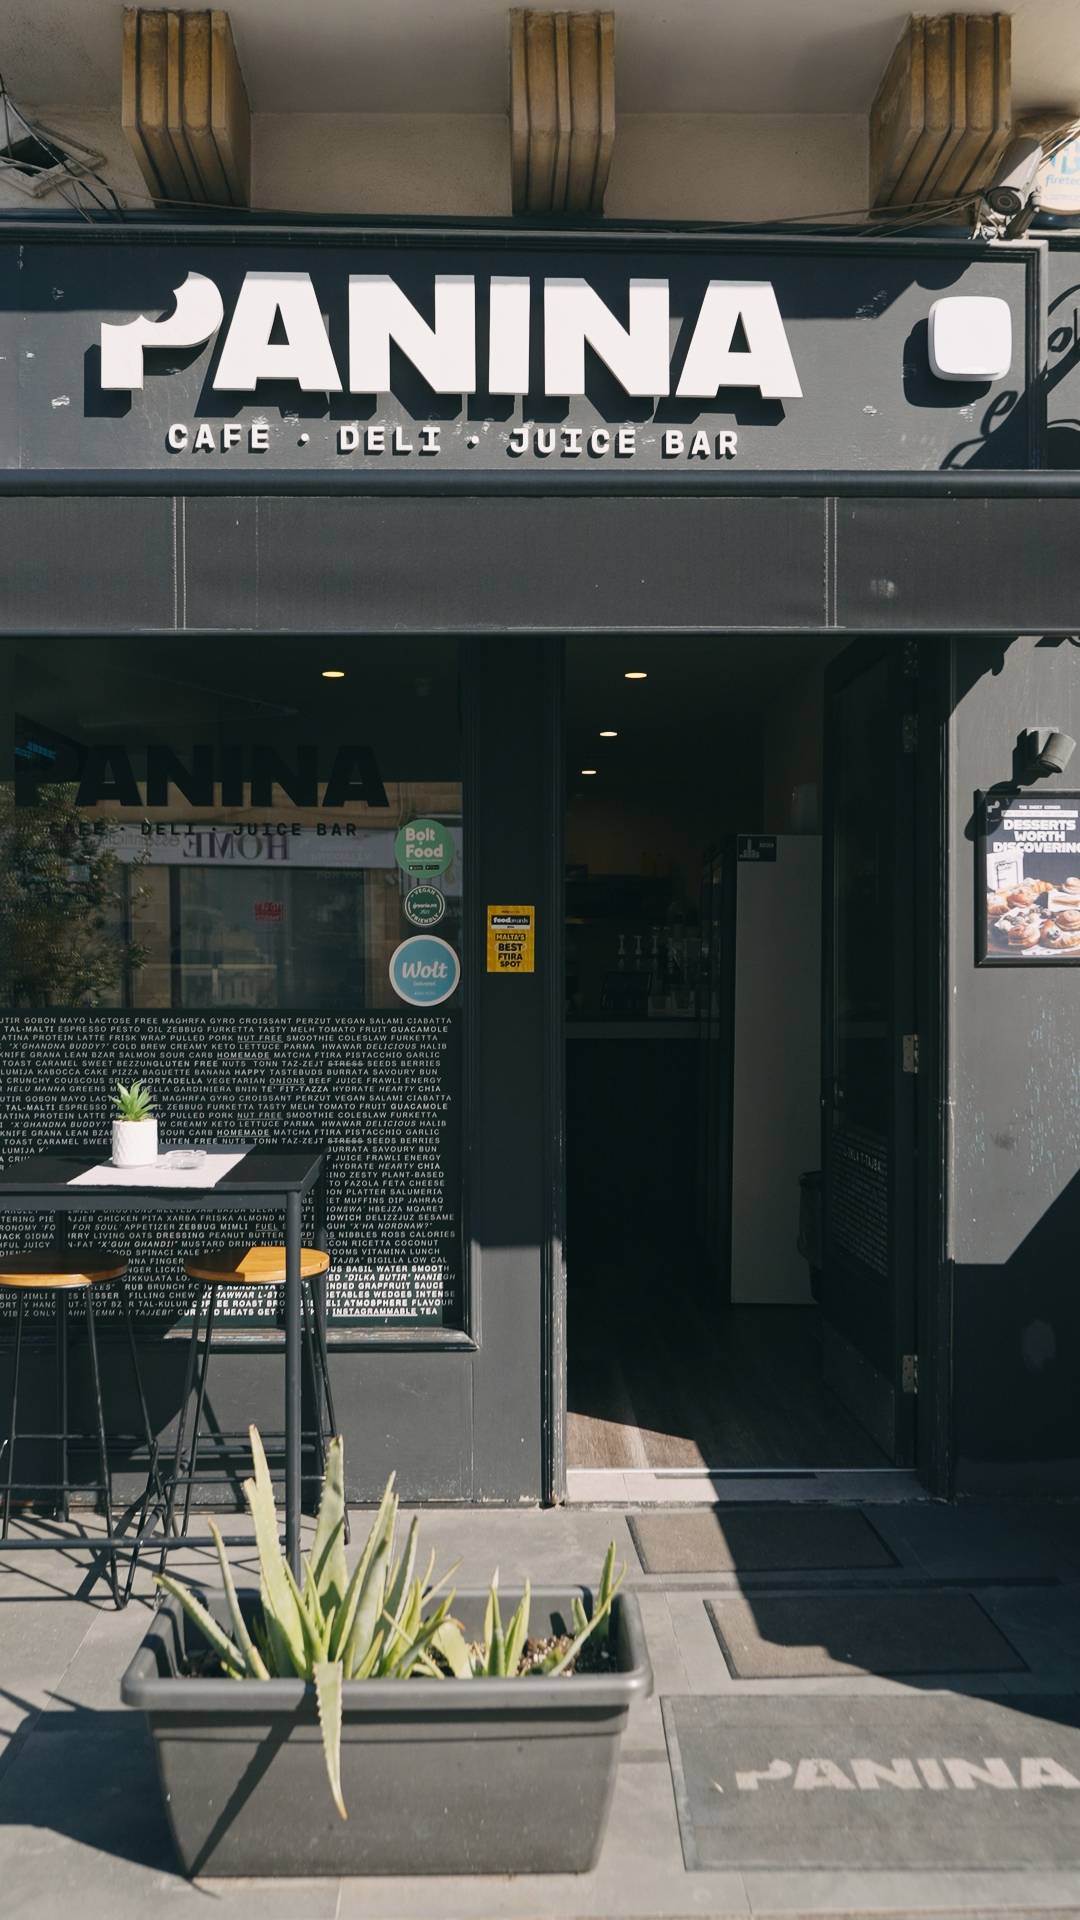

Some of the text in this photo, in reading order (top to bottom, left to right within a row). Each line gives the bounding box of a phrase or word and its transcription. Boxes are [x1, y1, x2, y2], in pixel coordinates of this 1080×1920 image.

[101, 271, 802, 398] PANINA
[168, 424, 738, 455] CAFE DELI JUICE BAR
[14, 744, 389, 807] PANINA
[1003, 819, 1076, 830] DESSERTS
[141, 822, 197, 837] DELI
[232, 822, 303, 837] JUICE
[316, 822, 358, 837] BAR
[405, 827, 436, 842] Bolt
[1013, 830, 1066, 842] WORTH
[405, 843, 444, 859] Food
[413, 887, 436, 896] VEGAN
[410, 911, 439, 924] FRIENDLY
[498, 942, 523, 952] BEST
[498, 952, 523, 961] FTIRA
[499, 960, 521, 968] SPOT
[401, 960, 449, 979] Wolt
[60, 1017, 86, 1025] MAYO
[89, 1017, 131, 1025] LACTOSE
[134, 1017, 158, 1025] FREE
[209, 1017, 236, 1025] GYRO
[238, 1017, 292, 1025] CROISSANT
[335, 1017, 366, 1025] VEGAN
[369, 1017, 403, 1025] SALAMI
[406, 1017, 452, 1025] CIABATTA
[4, 1025, 448, 1033] TAL-MALTI ESPRESSO PESTO OIL TASTY TOMATO FRUIT GUACAMOLE
[32, 1034, 74, 1042] PROTEIN
[77, 1034, 105, 1042] LATTE
[140, 1034, 166, 1042] WRAP
[170, 1034, 205, 1042] PULLED
[208, 1034, 233, 1042] PORK
[237, 1034, 255, 1042] NUT
[258, 1034, 282, 1042] FREE
[286, 1034, 334, 1042] SMOOTHIE
[338, 1034, 387, 1042] COLESLAW
[112, 1042, 417, 1050] COLD BREW CREAMY KETO LETTUCE PARMA DELICIOUS
[64, 1051, 440, 1059] LEAN SALMON SOUR CARB HOMEMADE MATCHA FTIRA PISTACCHIO GARLIC
[2, 1059, 441, 1067] TOAST CARAMEL SWEET FREE NUTS STRESS SEEDS BERRIES
[84, 1068, 438, 1076] CAKE PIZZA BAGUETTE BANANA HAPPY TASTEBUDS BURRATA SAVOURY BUN
[6, 1076, 442, 1084] CRUNCHY COUSCOUS MORTADELLA VEGETARIAN ONIONS BEEF JUICE FRAWLI ENERGY
[34, 1085, 66, 1093] MANNA
[68, 1085, 106, 1093] GREENS
[332, 1085, 374, 1093] HYDRATE
[378, 1085, 415, 1093] HEARTY
[418, 1085, 441, 1093] CHIA
[349, 1170, 445, 1178] ZESTY PLANT-BASED
[382, 1179, 406, 1187] FETA
[408, 1179, 445, 1187] CHEESE
[346, 1187, 443, 1195] PLATTER SALUMERIA
[344, 1196, 404, 1204] MUFFINS DIP
[97, 1214, 275, 1222] CHICKEN PITA FRISKA ALMOND
[418, 1213, 454, 1221] SESAME
[72, 1223, 91, 1231] FOR
[124, 1223, 175, 1231] APPETIZER
[255, 1223, 278, 1231] FUEL
[93, 1231, 284, 1239] LIVING OATS DRESSING PEANUT BUTTER
[338, 1230, 455, 1238] NIBBLES ROSS CALORIES
[23, 1240, 50, 1248] JUICY
[181, 1240, 257, 1248] MUSTARD DRINK
[351, 1239, 438, 1247] RICETTA COCONUT
[177, 1249, 199, 1257] KALE
[361, 1247, 440, 1255] VITAMINA LUNCH
[149, 1257, 185, 1265] FINGER
[367, 1256, 404, 1264] BIGILLA
[407, 1256, 427, 1264] LOW
[345, 1264, 450, 1272] BASIL WATER SMOOTH
[124, 1282, 184, 1290] RUB BRUNCH
[414, 1281, 443, 1289] SAUCE
[128, 1291, 196, 1299] FILLING CHEW
[373, 1290, 455, 1298] WEDGES INTENSE
[232, 1299, 263, 1307] ROAST
[343, 1298, 454, 1306] ATMOSPHERE FLAVOUR
[223, 1308, 254, 1316] MEATS
[332, 1307, 438, 1315] INSTAGRAMMABLE TEA
[735, 1757, 1080, 1791] PANINA
